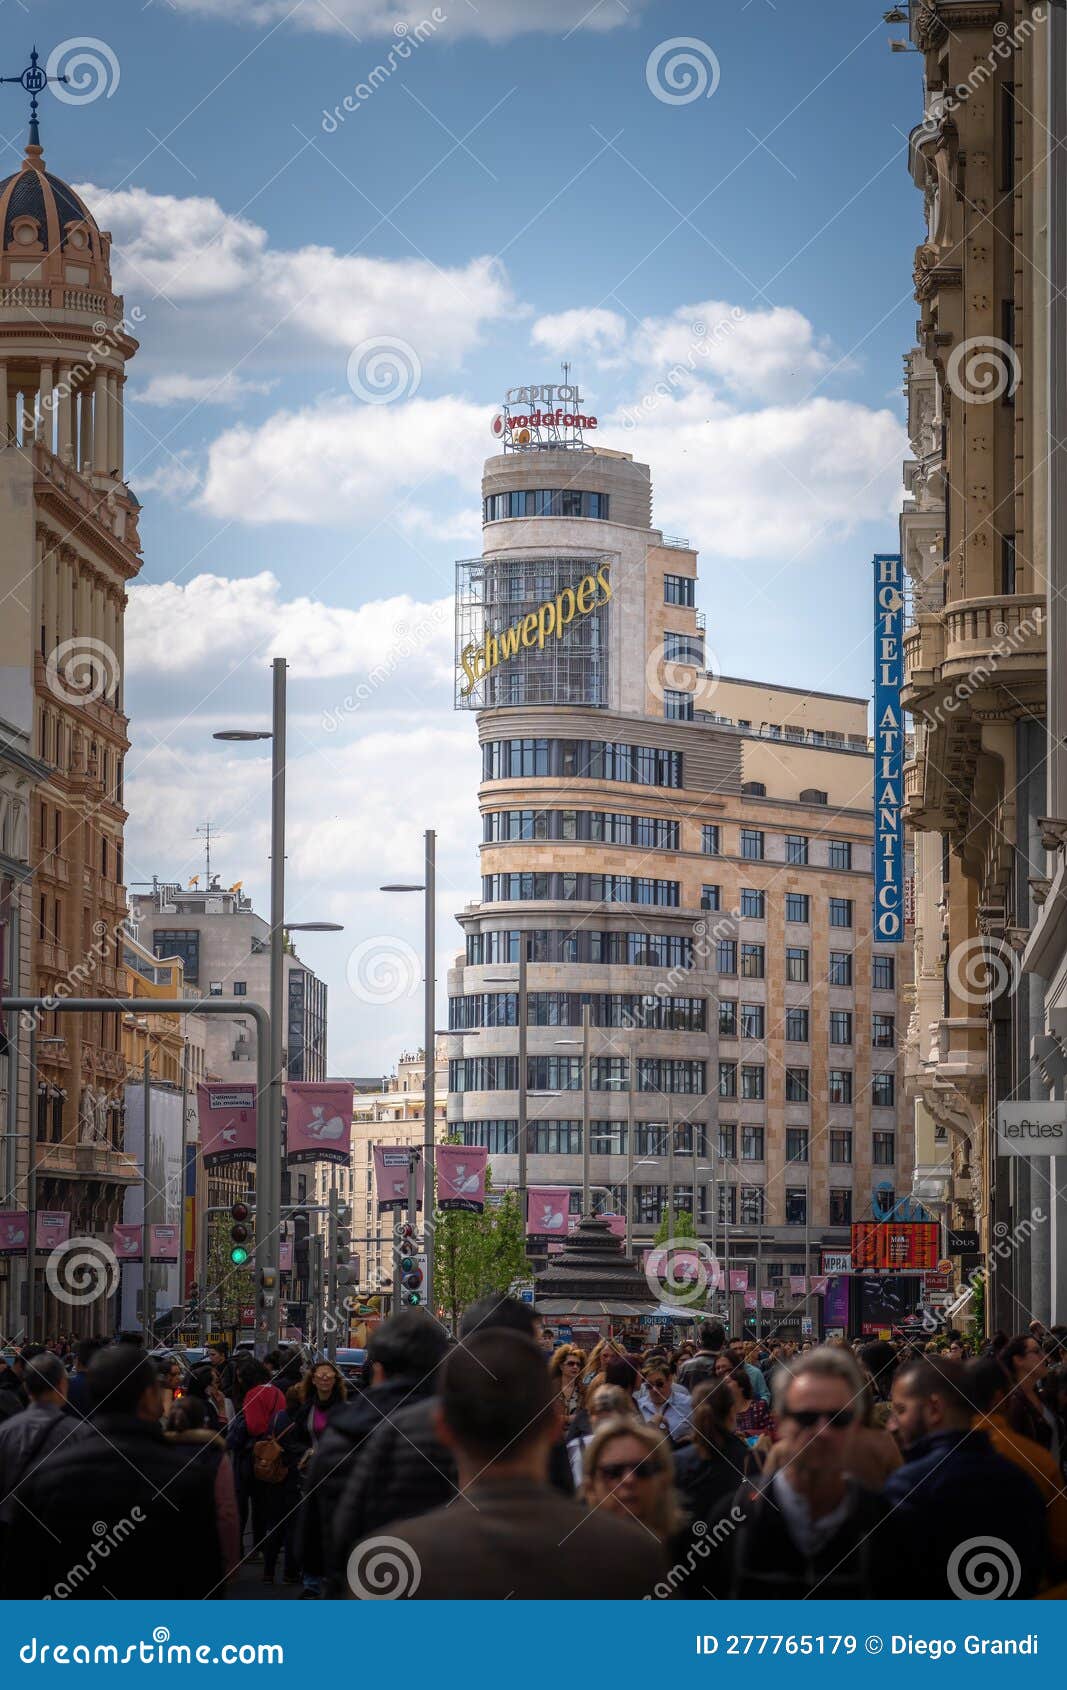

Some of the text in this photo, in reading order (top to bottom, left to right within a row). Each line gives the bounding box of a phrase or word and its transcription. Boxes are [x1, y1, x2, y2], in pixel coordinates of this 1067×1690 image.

[505, 384, 584, 402] CAPITOL
[507, 408, 598, 430] vodafone
[460, 563, 612, 696] Schweppes
[878, 560, 900, 936] HOTEL ATLANTICO
[1003, 1120, 1064, 1138] lefties
[950, 1239, 976, 1247] TOUS
[243, 1309, 256, 1317] KF
